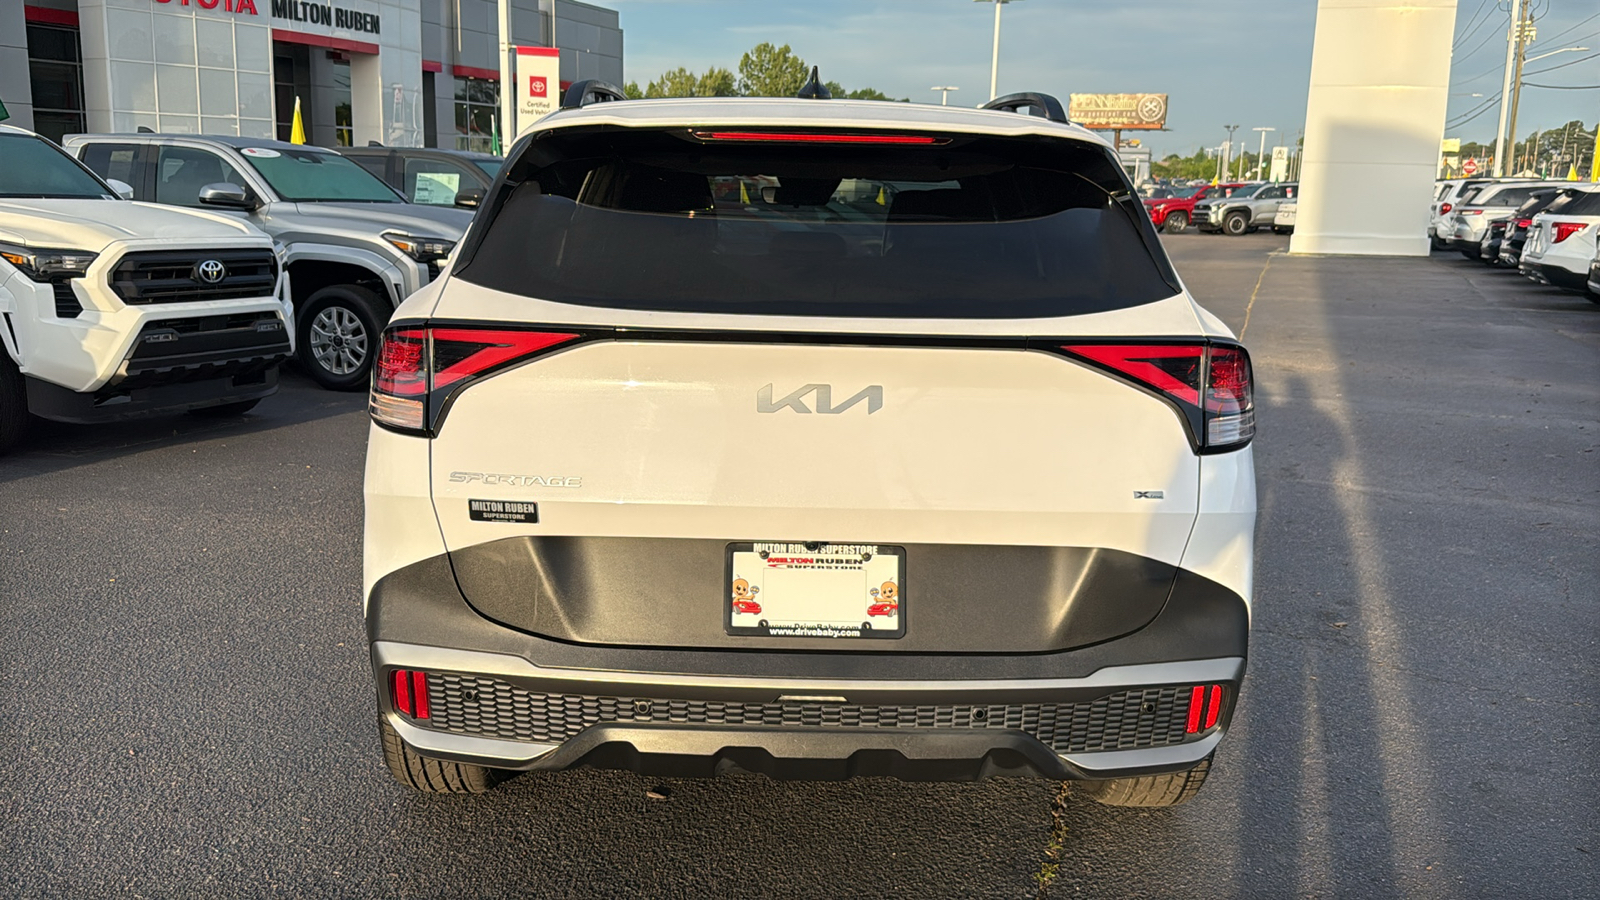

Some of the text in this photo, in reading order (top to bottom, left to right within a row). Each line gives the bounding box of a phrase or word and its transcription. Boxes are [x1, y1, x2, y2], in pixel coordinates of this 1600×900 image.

[272, 0, 332, 27] MILTON
[335, 8, 380, 34] RUBEN
[757, 383, 883, 415] KIA
[449, 471, 582, 488] SPORTAGE
[471, 500, 535, 514] MILTON RUBEN
[482, 512, 526, 520] SUPERSTORE
[753, 543, 787, 554] MILTON
[819, 545, 878, 555] SUPERSTORE
[769, 627, 861, 638] www.drivebaby.com
